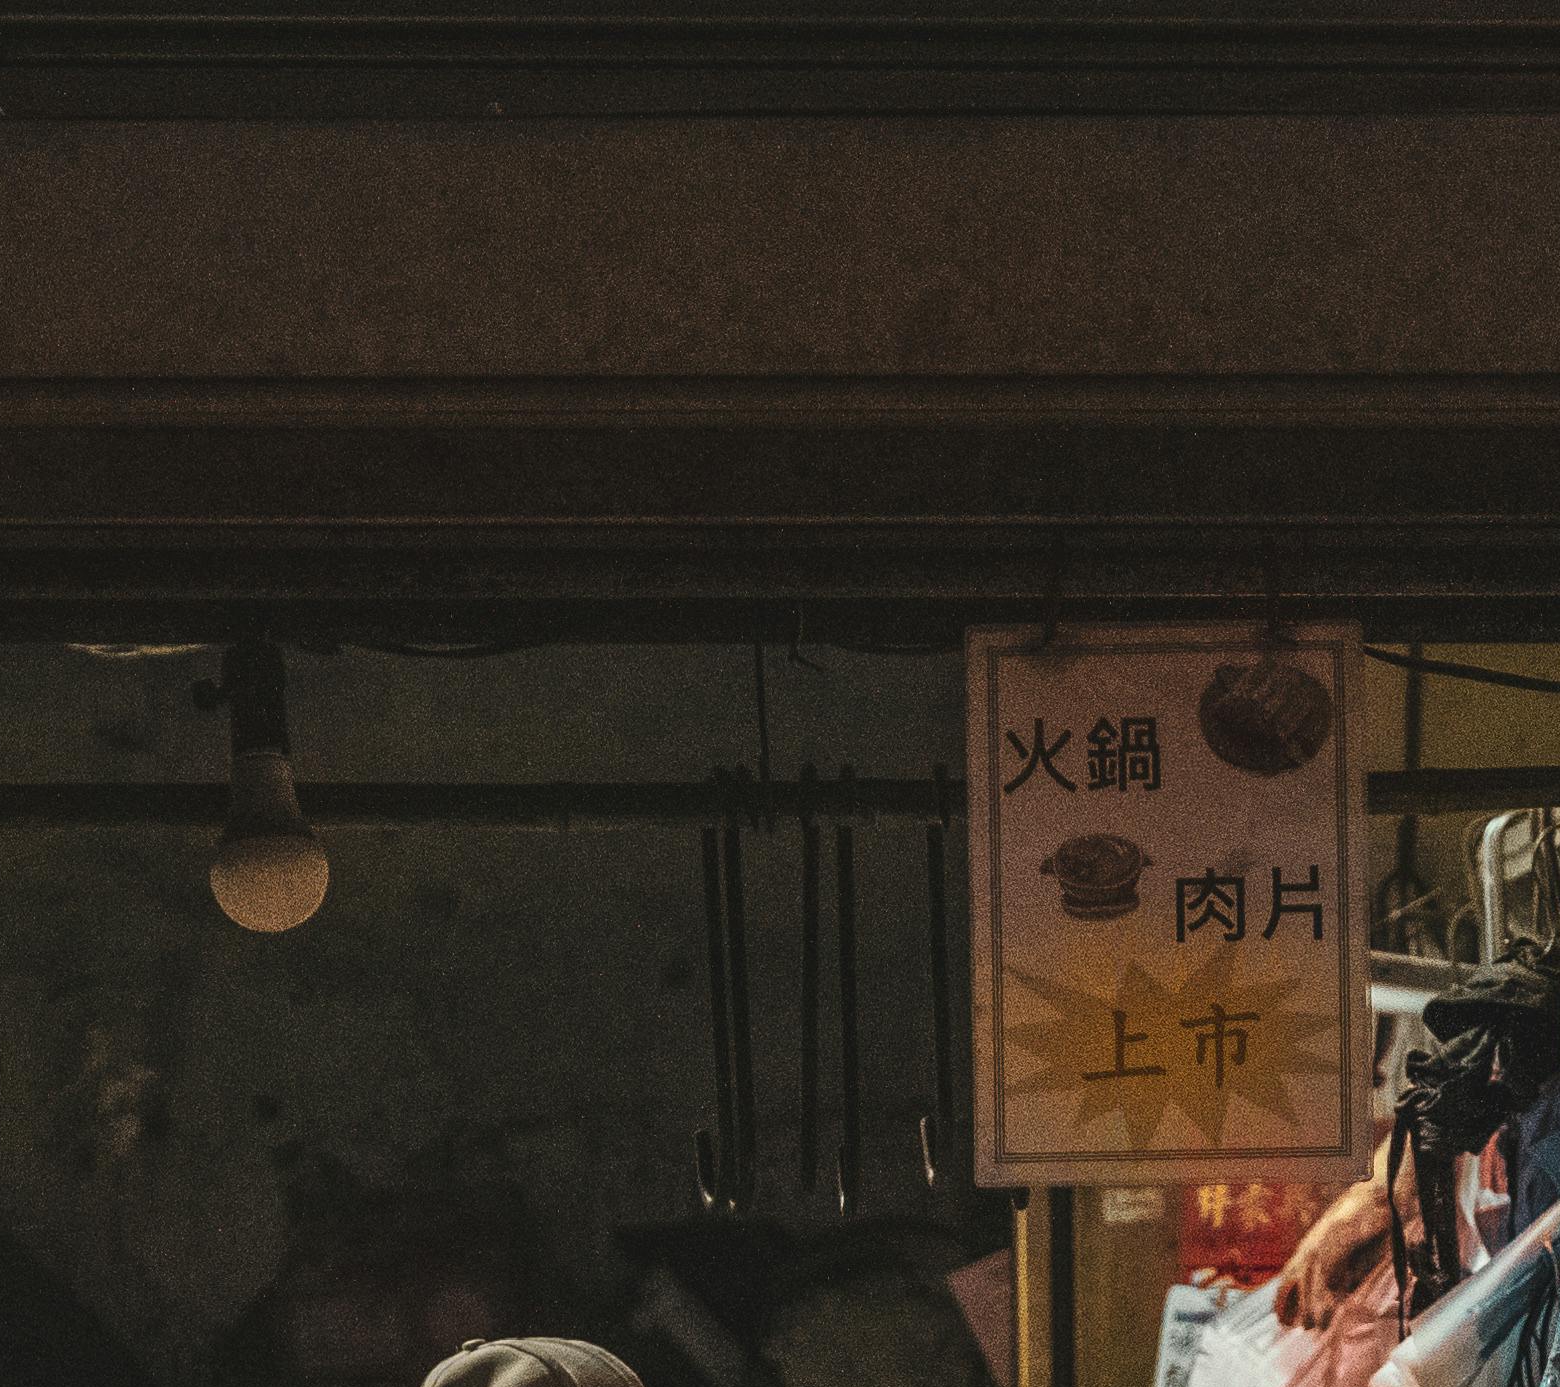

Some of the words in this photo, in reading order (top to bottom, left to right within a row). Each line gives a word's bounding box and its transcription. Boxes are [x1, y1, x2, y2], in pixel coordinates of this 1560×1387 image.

[1002, 715, 1163, 793] 火鍋
[1174, 864, 1326, 942] 肉片
[1082, 1003, 1262, 1089] 上市
